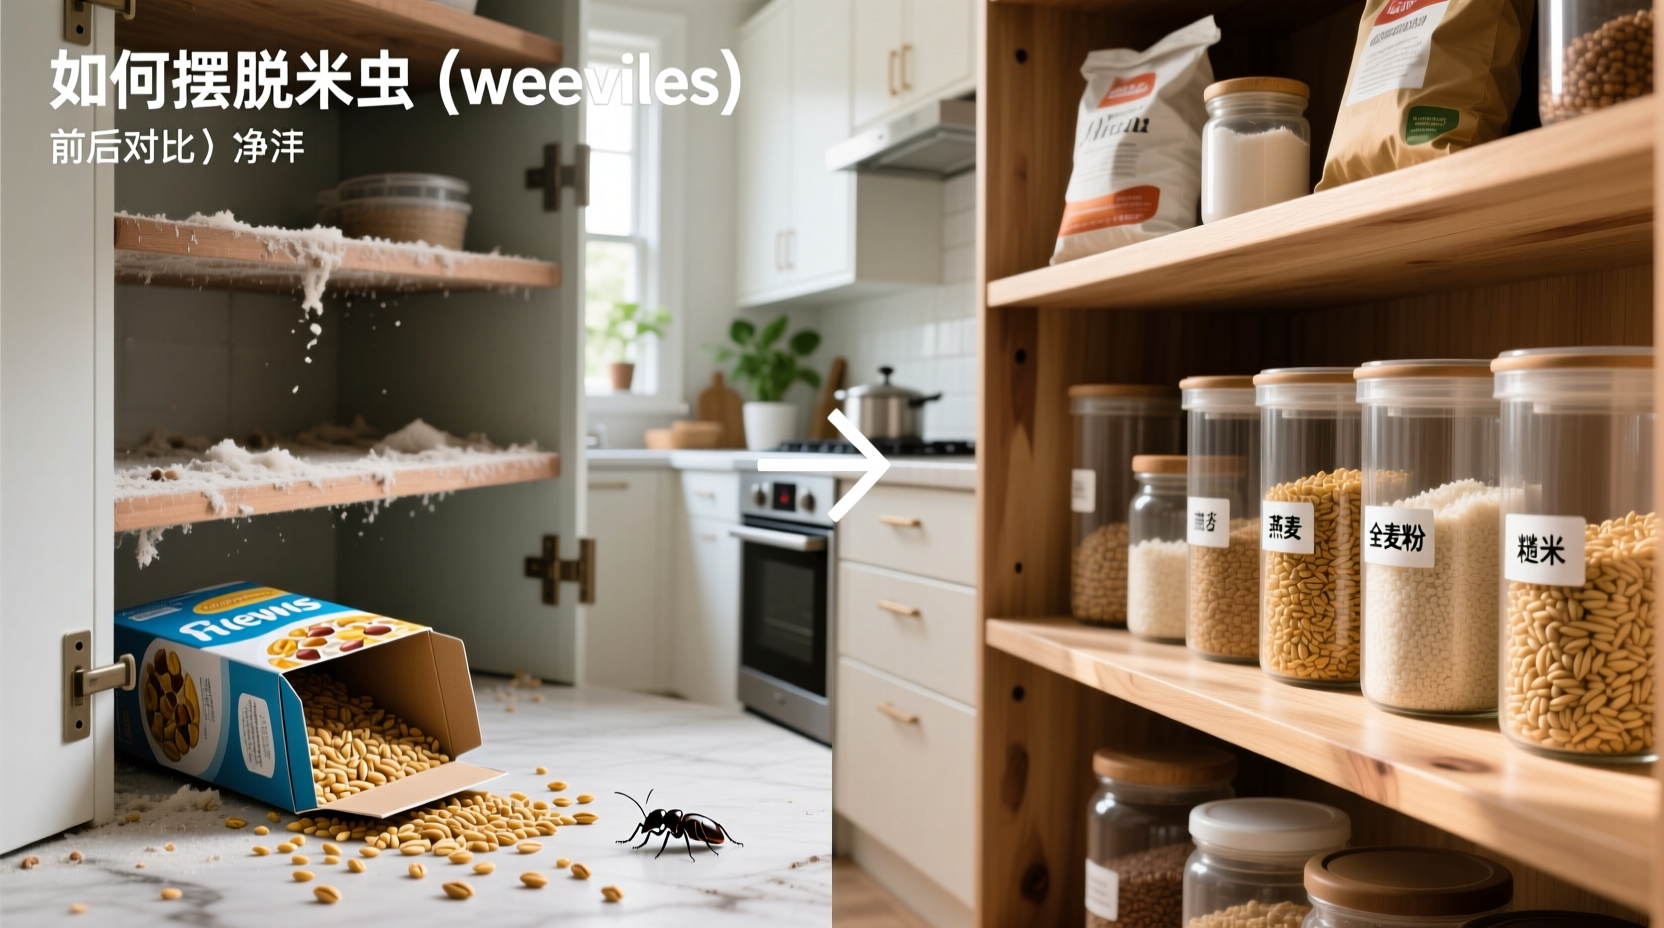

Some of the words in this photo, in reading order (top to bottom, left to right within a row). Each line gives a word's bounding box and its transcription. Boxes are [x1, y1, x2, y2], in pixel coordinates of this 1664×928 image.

[1269, 515, 1303, 542] 燕麦
[1369, 521, 1426, 552] 全麦粉
[1517, 533, 1566, 566] 糙米
